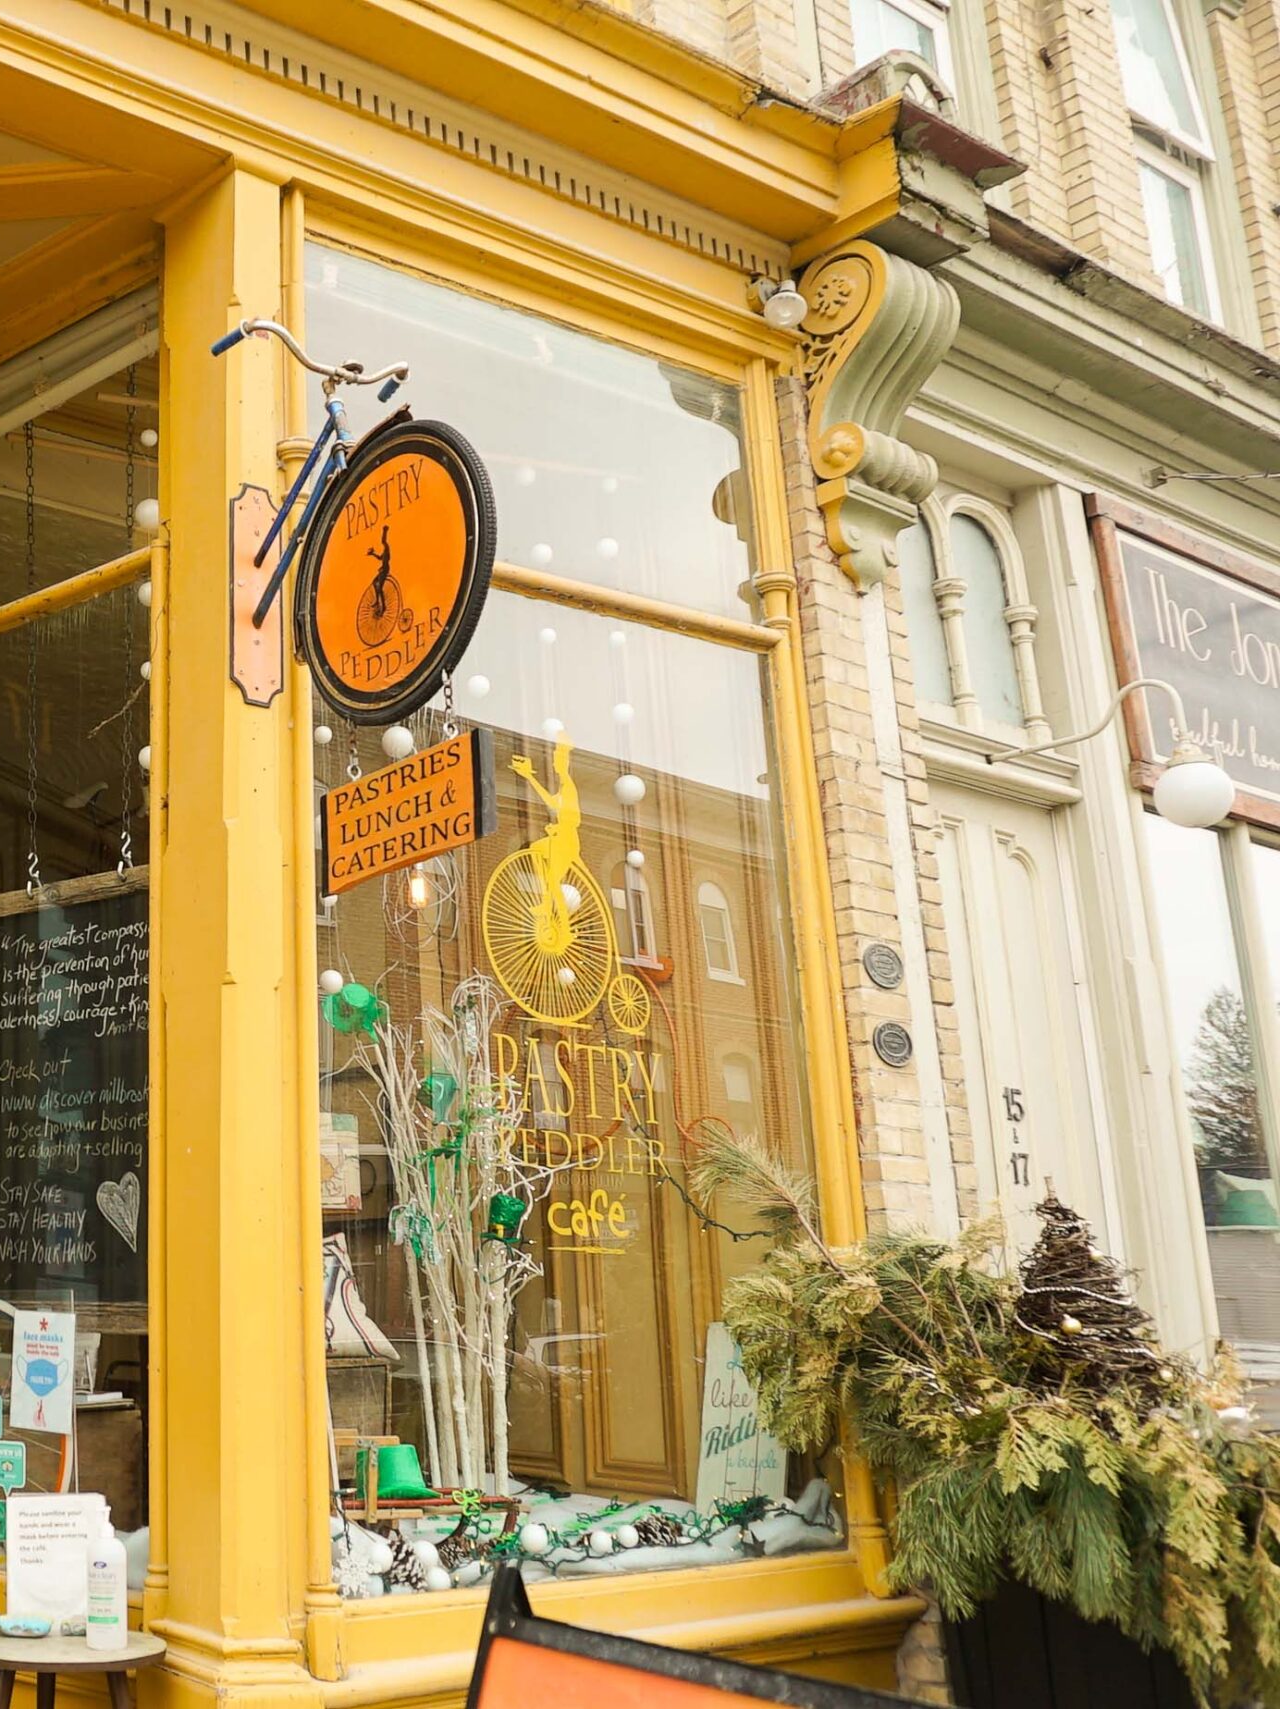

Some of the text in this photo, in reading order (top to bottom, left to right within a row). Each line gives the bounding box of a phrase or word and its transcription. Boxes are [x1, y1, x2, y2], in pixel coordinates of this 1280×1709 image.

[345, 459, 424, 541] PASTRY
[1144, 566, 1211, 661] The
[340, 607, 442, 682] PEDDLER
[334, 742, 461, 815] PASTRIES
[340, 779, 457, 845] LUNCH &
[331, 812, 471, 879] CATERING
[14, 963, 37, 987] the
[41, 951, 109, 989] prevention
[113, 943, 130, 966] of
[31, 922, 99, 970] greatest
[94, 921, 149, 951] compassi
[0, 985, 62, 1024] suffering
[65, 974, 114, 1007] through
[64, 1004, 118, 1038] courage
[43, 1049, 72, 1076] out
[492, 1033, 662, 1125] PASTRY
[1002, 1086, 1025, 1122] 15
[4, 1121, 20, 1138] to
[44, 1116, 72, 1140] how
[75, 1119, 97, 1131] our
[5, 1145, 26, 1159] are
[91, 1135, 143, 1168] selling
[497, 1126, 671, 1177] PEDDLER
[32, 1178, 62, 1203] SAFE
[1010, 1152, 1030, 1187] 17
[32, 1205, 87, 1237] HEALTHY
[547, 1189, 630, 1238] café
[31, 1236, 61, 1265] YOUR
[62, 1236, 97, 1265] HANDS
[710, 1378, 752, 1409] like
[704, 1412, 766, 1459] Ridi
